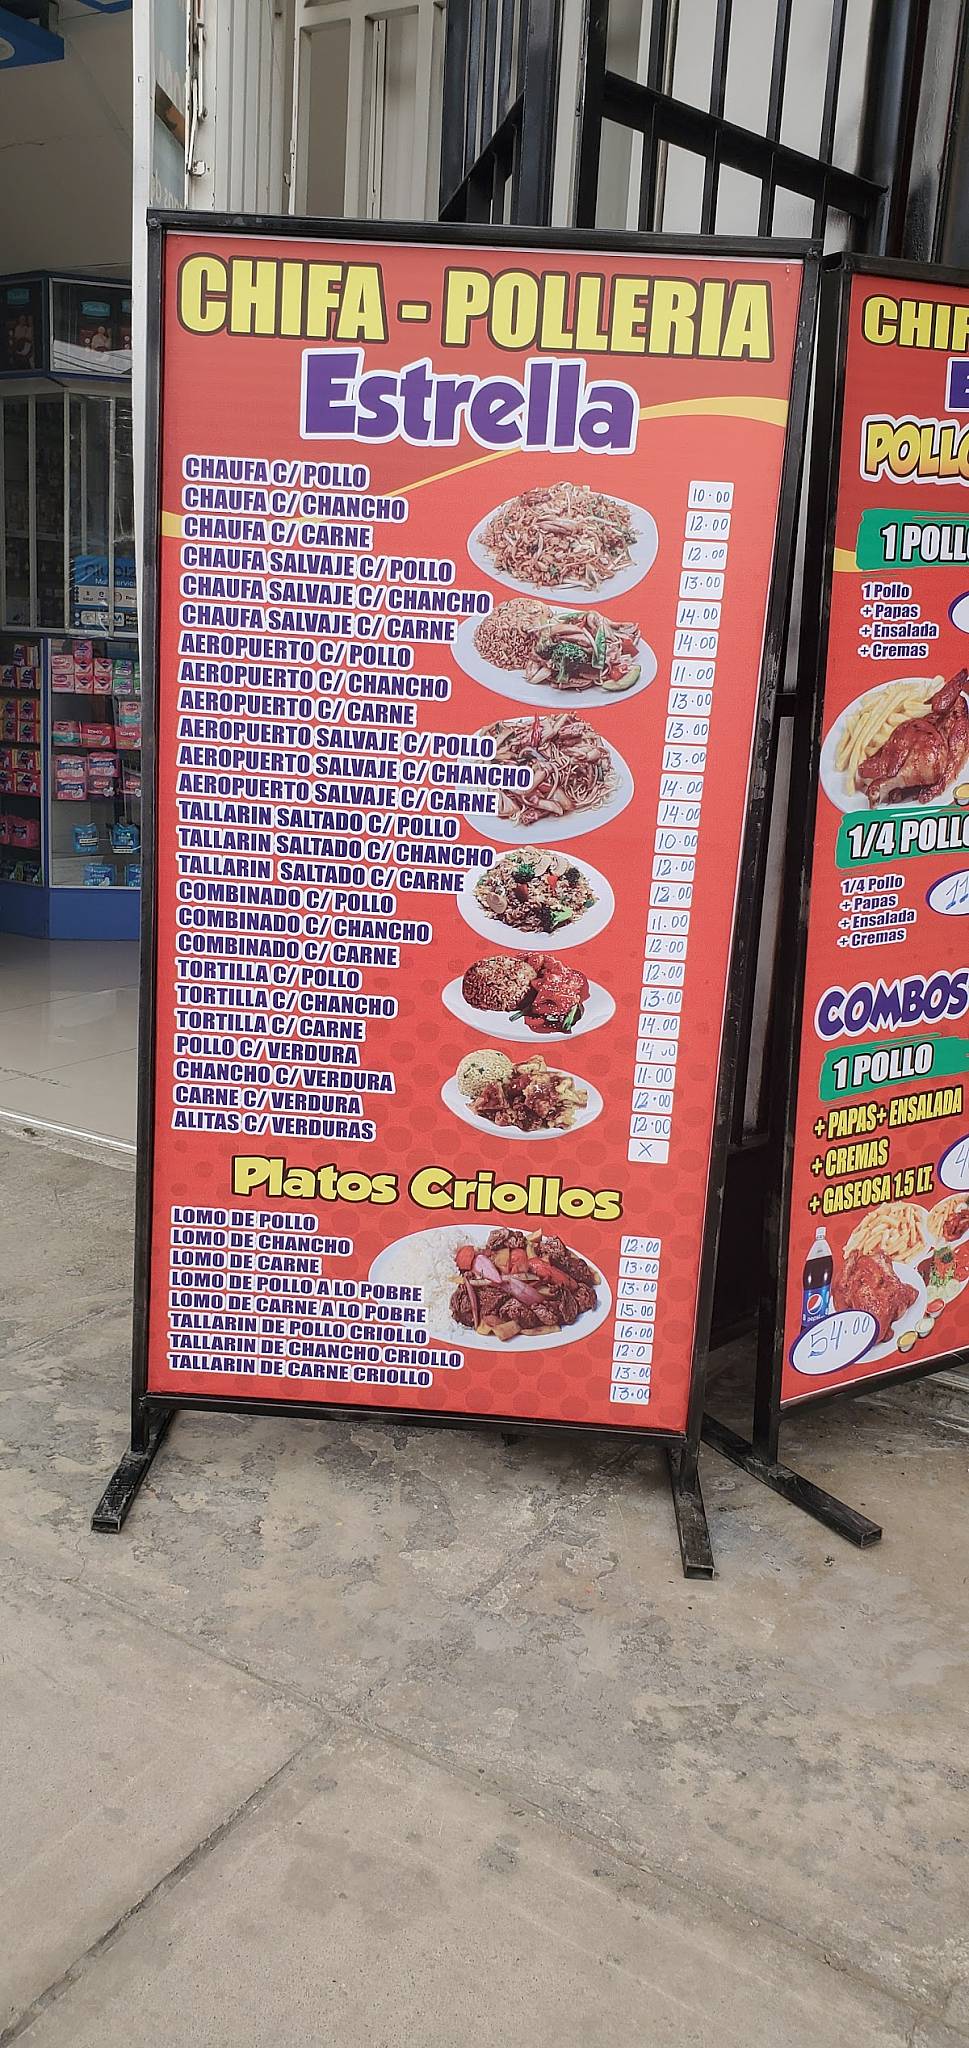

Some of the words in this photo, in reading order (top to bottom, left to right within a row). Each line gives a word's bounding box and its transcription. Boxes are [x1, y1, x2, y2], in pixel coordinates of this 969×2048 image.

[178, 254, 386, 342] CHIFA
[445, 268, 773, 361] POLLERIA
[303, 351, 637, 450] Estrella
[185, 457, 268, 482] CHAUFA
[273, 462, 299, 484] C/
[303, 464, 367, 488] POLLO
[185, 487, 267, 512] CHAUFA
[272, 492, 298, 514] C/
[302, 494, 405, 521] CHANCHO
[184, 516, 266, 542] CHAUFA
[271, 522, 297, 544] C/
[301, 524, 370, 548] CARNE
[881, 524, 897, 561] 1
[902, 523, 969, 561] POLL
[183, 546, 265, 571] CHAUFA
[270, 551, 355, 577] SALVAJE
[359, 557, 386, 579] C/
[389, 559, 452, 583] POLLO
[863, 584, 871, 598] 1
[874, 583, 910, 598] Pollo
[182, 604, 264, 629] CHAUFA
[268, 609, 352, 635] SALVAJE
[357, 616, 383, 637] C/
[387, 618, 455, 641] CARNE
[875, 604, 918, 620] Papas
[873, 623, 937, 638] Ensalada
[181, 633, 314, 661] AEROPUERTO
[319, 642, 345, 664] C/
[349, 644, 411, 668] POLLO
[872, 643, 927, 657] Cremas
[180, 661, 313, 690] AEROPUERTO
[318, 671, 344, 692] C/
[348, 673, 449, 699] CHANCHO
[180, 689, 312, 718] AEROPUERTO
[317, 699, 343, 720] C/
[347, 701, 414, 725] CARNE
[178, 773, 310, 801] AEROPUERTO
[314, 783, 396, 807] SALVAJE
[401, 789, 426, 809] C/
[430, 790, 496, 814] CARNE
[178, 800, 272, 826] TALLARIN
[277, 807, 363, 832] SALTADO
[368, 814, 393, 834] C/
[397, 816, 457, 839] POLLO
[848, 822, 895, 858] 1/4
[179, 881, 301, 908] COMBINADO
[306, 890, 330, 910] C/
[334, 892, 394, 914] POLLO
[843, 879, 865, 894] 1/4
[868, 875, 903, 891] Pollo
[852, 909, 915, 929] Ensalada
[853, 895, 896, 911] Papas
[178, 907, 300, 934] COMBINADO
[305, 916, 330, 936] C/
[334, 918, 430, 942] CHANCHO
[851, 929, 905, 947] Cremas
[178, 933, 300, 959] COMBINADO
[304, 942, 329, 961] C/
[333, 944, 397, 966] CARNE
[177, 959, 269, 983] TORTILLA
[273, 965, 297, 985] C/
[301, 967, 360, 989] POLLO
[177, 984, 268, 1008] TORTILLA
[272, 991, 296, 1010] C/
[300, 993, 395, 1017] CHANCHO
[817, 971, 969, 1036] COMBOS
[176, 1010, 267, 1034] TORTILLA
[271, 1016, 296, 1035] C/
[299, 1018, 363, 1040] CARNE
[176, 1035, 235, 1057] POLLO
[239, 1039, 263, 1058] C/
[267, 1041, 358, 1065] VERDURA
[833, 1057, 848, 1090] 1
[852, 1043, 933, 1086] POLLO
[176, 1060, 271, 1084] CHANCHO
[275, 1067, 299, 1085] C/
[303, 1068, 393, 1092] VERDURA
[175, 1085, 239, 1106] CARNE
[243, 1090, 267, 1108] C/
[271, 1091, 361, 1115] VERDURA
[888, 1087, 962, 1127] ENSALADA
[174, 1110, 239, 1131] ALITAS
[244, 1114, 268, 1133] C/
[271, 1116, 373, 1140] VERDURAS
[825, 1138, 889, 1177] CREMAS
[234, 1156, 398, 1204] Platos
[410, 1167, 623, 1221] Criollos
[823, 1174, 891, 1214] GASEOSA
[893, 1169, 914, 1198] 1.5
[173, 1207, 226, 1226] LOMO
[231, 1211, 255, 1227] DE
[259, 1213, 316, 1231] POLLO
[173, 1229, 226, 1247] LOMO
[230, 1232, 254, 1248] DE
[258, 1234, 350, 1255] CHANCHO
[172, 1250, 225, 1268] LOMO
[229, 1253, 253, 1269] DE
[257, 1255, 319, 1274] CARNE
[172, 1271, 224, 1289] LOMO
[229, 1274, 252, 1290] DE
[256, 1276, 313, 1295] POLLO
[316, 1280, 330, 1296] A
[334, 1281, 356, 1297] LO
[360, 1283, 422, 1302] POBRE
[171, 1292, 223, 1309] LOMO
[228, 1295, 251, 1311] DE
[256, 1297, 318, 1316] CARNE
[321, 1302, 334, 1317] A
[338, 1303, 360, 1319] LO
[364, 1304, 426, 1323] POBRE
[170, 1312, 257, 1332] TALLARIN
[261, 1318, 285, 1334] DE
[289, 1320, 345, 1338] POLLO
[350, 1325, 427, 1344] CRIOLLO
[170, 1333, 256, 1353] TALLARIN
[261, 1339, 284, 1355] DE
[288, 1342, 380, 1362] CHANCHO
[384, 1348, 461, 1368] CRIOLLO
